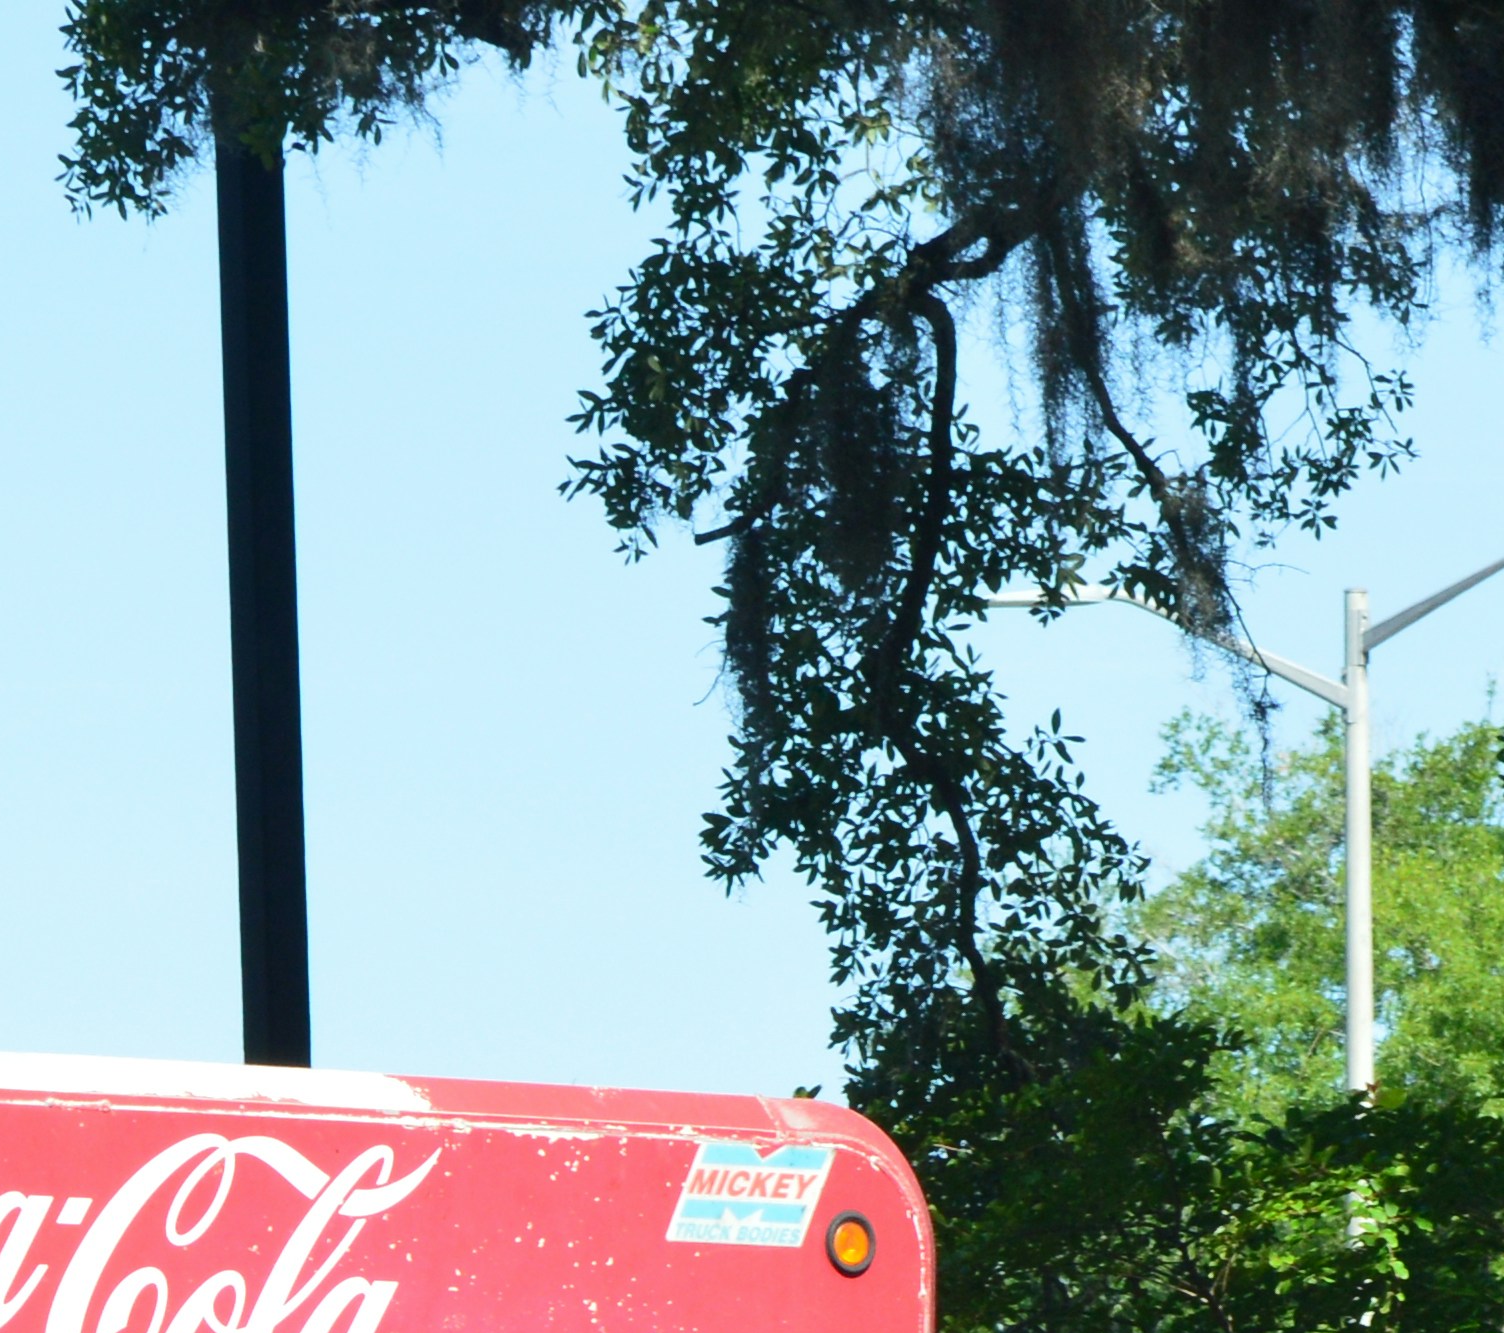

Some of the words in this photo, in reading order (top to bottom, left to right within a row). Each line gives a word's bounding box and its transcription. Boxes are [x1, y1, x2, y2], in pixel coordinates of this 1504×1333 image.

[688, 1168, 818, 1200] MICKEY
[675, 1222, 732, 1241] TRUCK
[736, 1225, 801, 1244] BODIES
